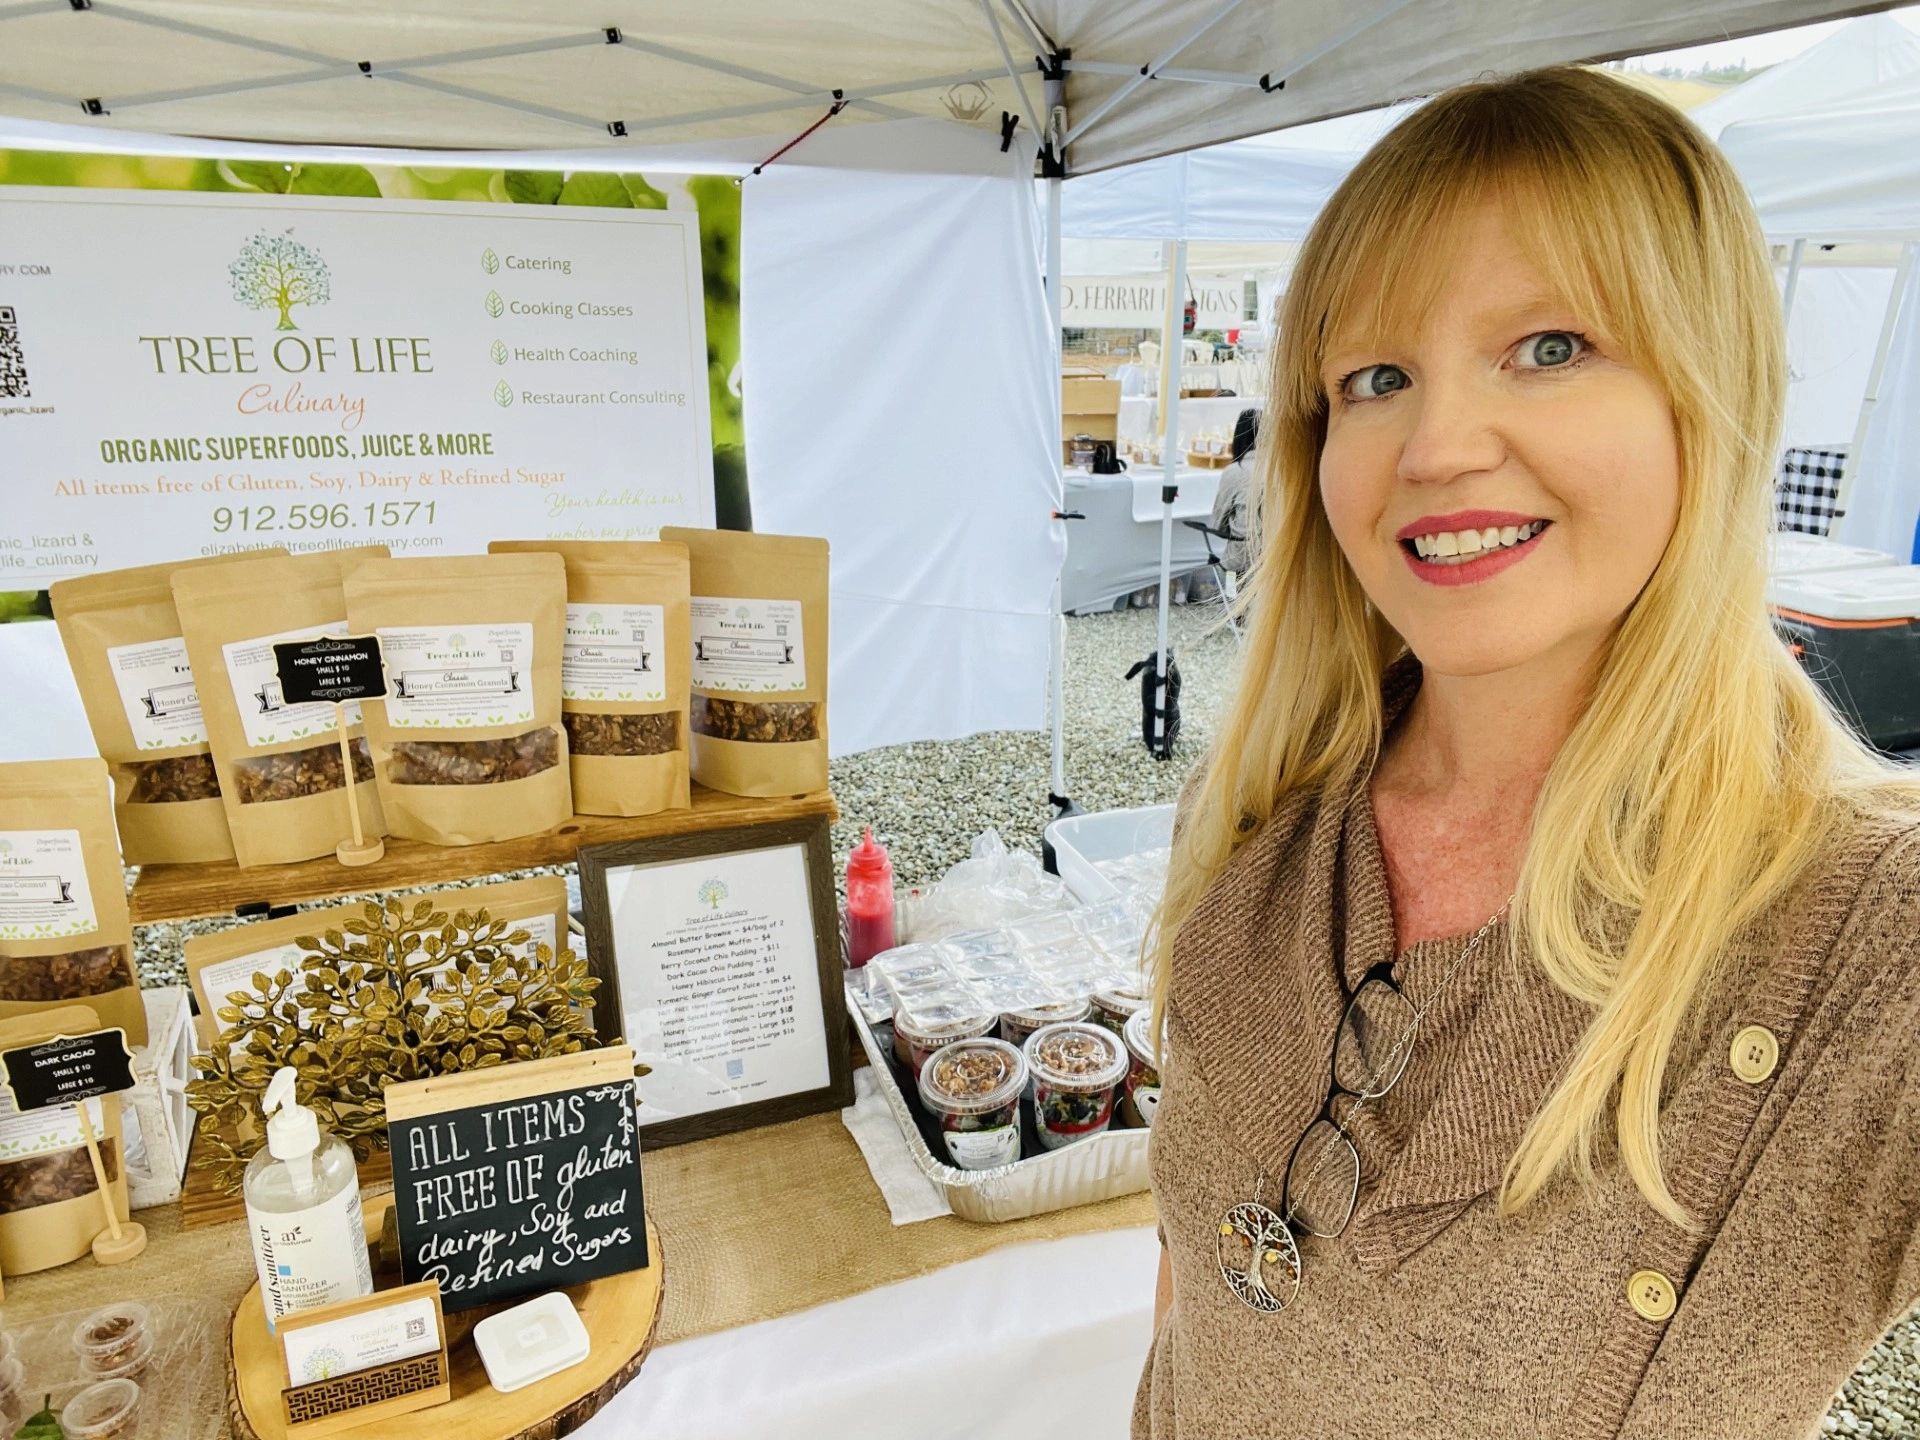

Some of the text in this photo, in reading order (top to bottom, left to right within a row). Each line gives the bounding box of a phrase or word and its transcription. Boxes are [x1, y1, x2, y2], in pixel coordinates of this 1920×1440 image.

[505, 255, 572, 275] Catering
[1084, 285, 1155, 311] FERRARI
[510, 301, 633, 319] Cooking Classes
[138, 335, 434, 375] TREE OF LIFE
[515, 347, 638, 365] Health Coaching
[237, 382, 366, 431] Culinary
[522, 390, 686, 408] Restaurant Consulting
[100, 432, 494, 463] ORGANIC SUPERFOODS, JUICE & MORE
[54, 479, 85, 497] All
[94, 478, 149, 496] items
[155, 476, 192, 494] free
[201, 474, 223, 492] of
[228, 473, 303, 492] Gluten,
[359, 470, 411, 492] Dairy
[418, 472, 433, 486] &
[440, 468, 511, 485] Refined
[516, 468, 566, 489] Sugar
[213, 500, 436, 533] 912.596.1571
[82, 532, 95, 547] &
[0, 552, 98, 569] life_culinary
[294, 652, 368, 666] HONEY CINNAMON
[426, 651, 450, 660] Tree
[465, 650, 486, 659] Life
[316, 665, 334, 675] SMALL
[319, 677, 335, 686] LARGE
[407, 680, 508, 691] Honey Cinnamon Granola
[651, 939, 677, 949] Almond
[680, 935, 703, 944] Butter
[667, 946, 701, 958] Rosemary
[704, 943, 726, 952] Lemon
[728, 938, 752, 947] Muffin
[661, 962, 681, 971] Berry
[684, 956, 711, 967] Coconut
[731, 948, 757, 959] Pudding
[727, 960, 753, 971] Pudding
[34, 1049, 96, 1068] DARK CACAO
[53, 1067, 74, 1078] SMALL
[58, 1080, 77, 1091] LARGE
[408, 1095, 585, 1171] ALL ITEMS
[412, 1134, 634, 1225] FREE OF gluten
[417, 1188, 628, 1267] dairy, Soy and
[421, 1226, 633, 1296] Refined Sugars
[280, 1276, 307, 1285] HAND
[281, 1280, 328, 1292] SANITIZER
